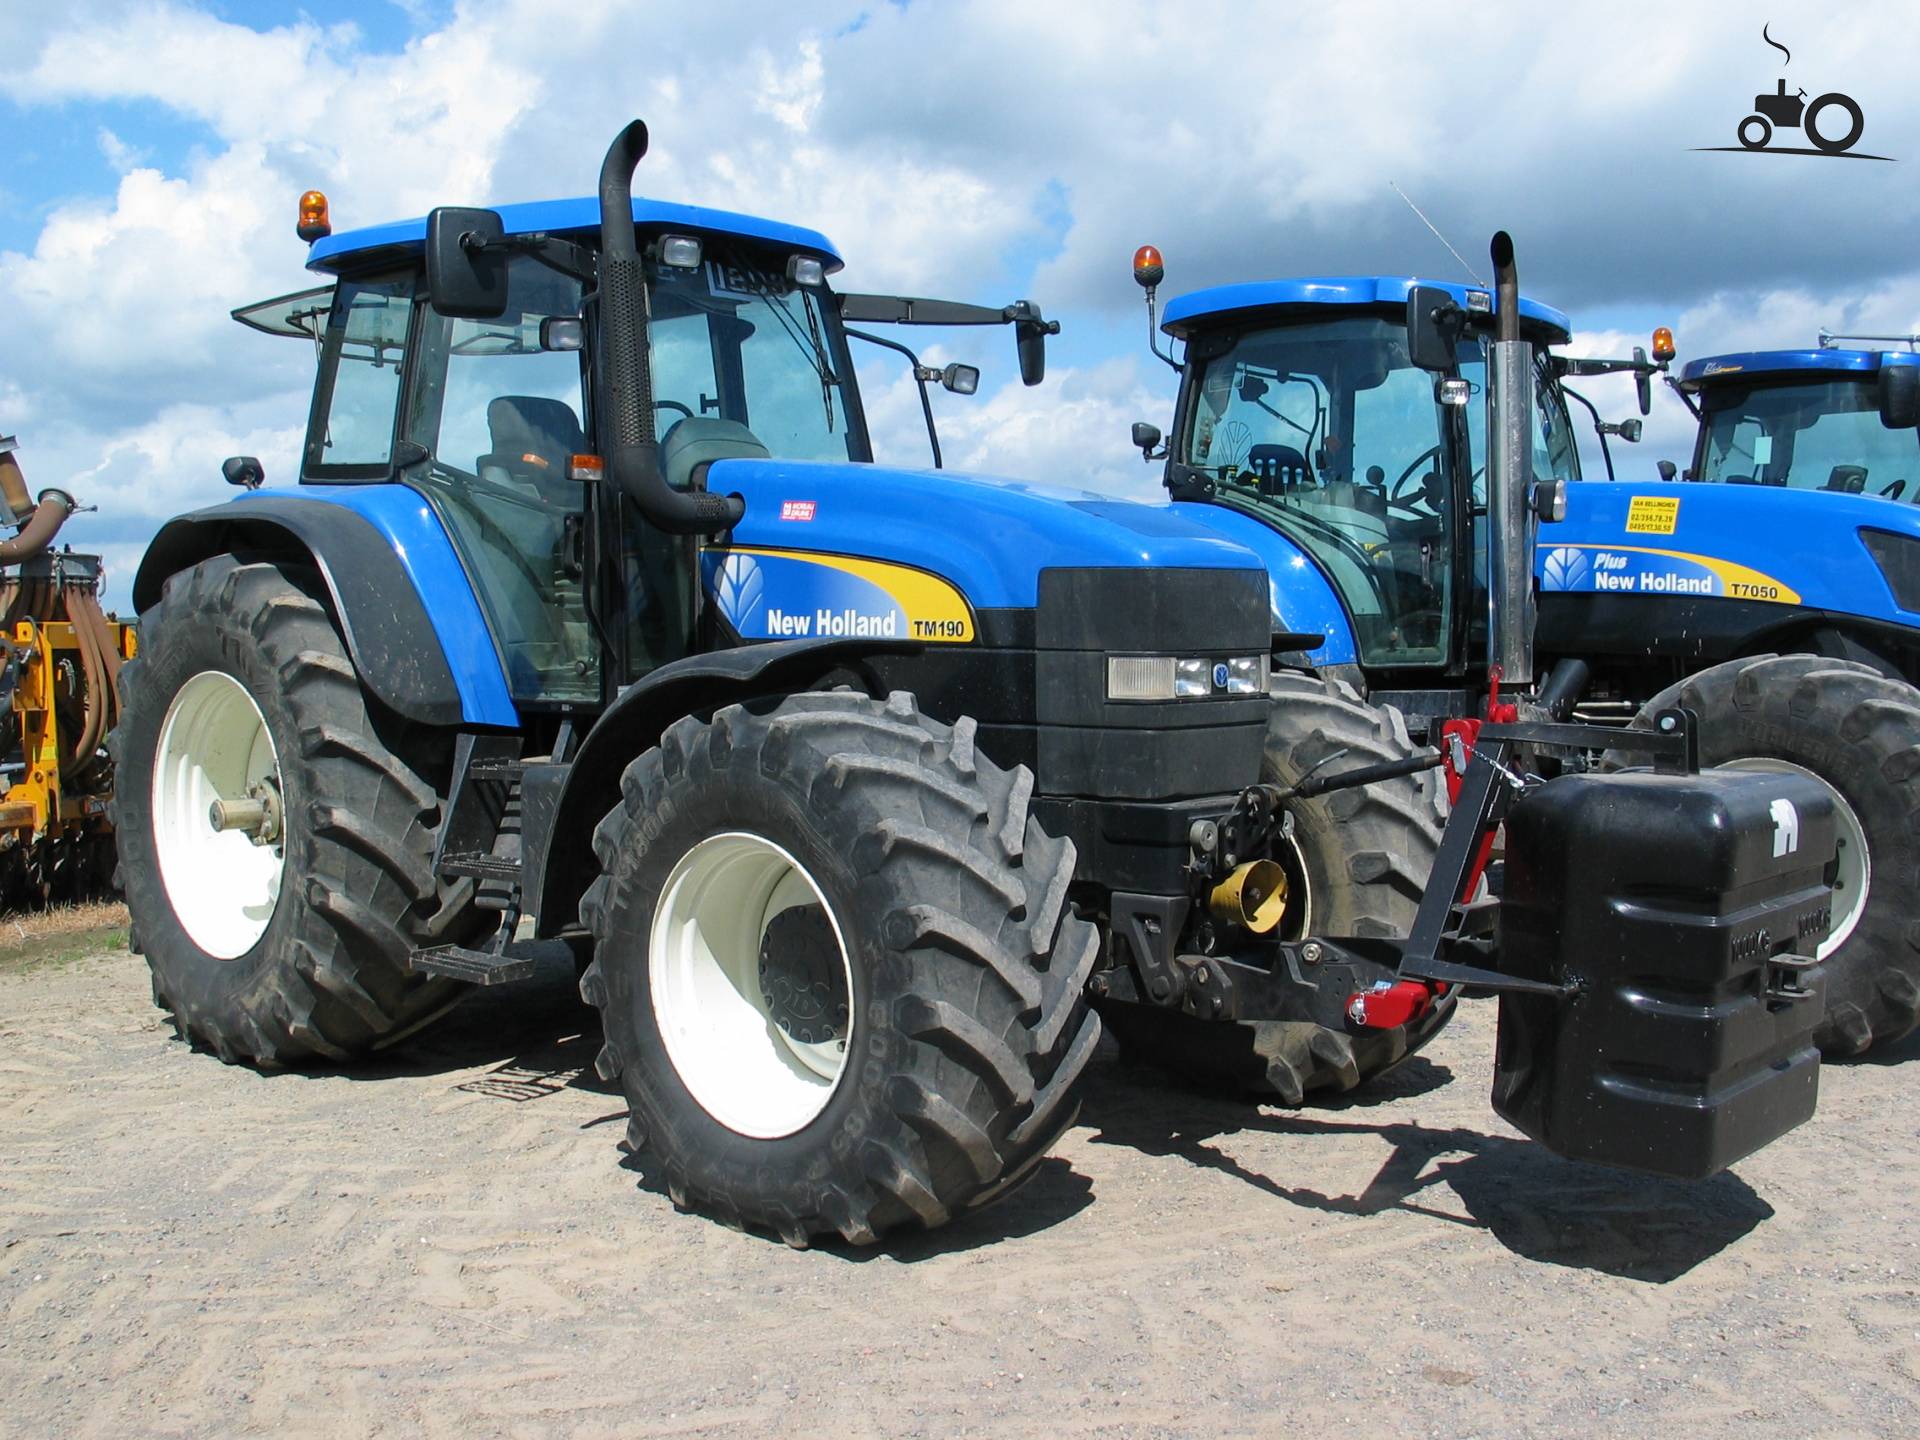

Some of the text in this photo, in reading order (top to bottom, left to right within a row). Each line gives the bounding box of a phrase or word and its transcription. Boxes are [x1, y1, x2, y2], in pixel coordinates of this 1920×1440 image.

[1593, 553, 1628, 569] Plus
[1595, 572, 1778, 599] New Holland T7050
[768, 609, 964, 637] New Holland TM190
